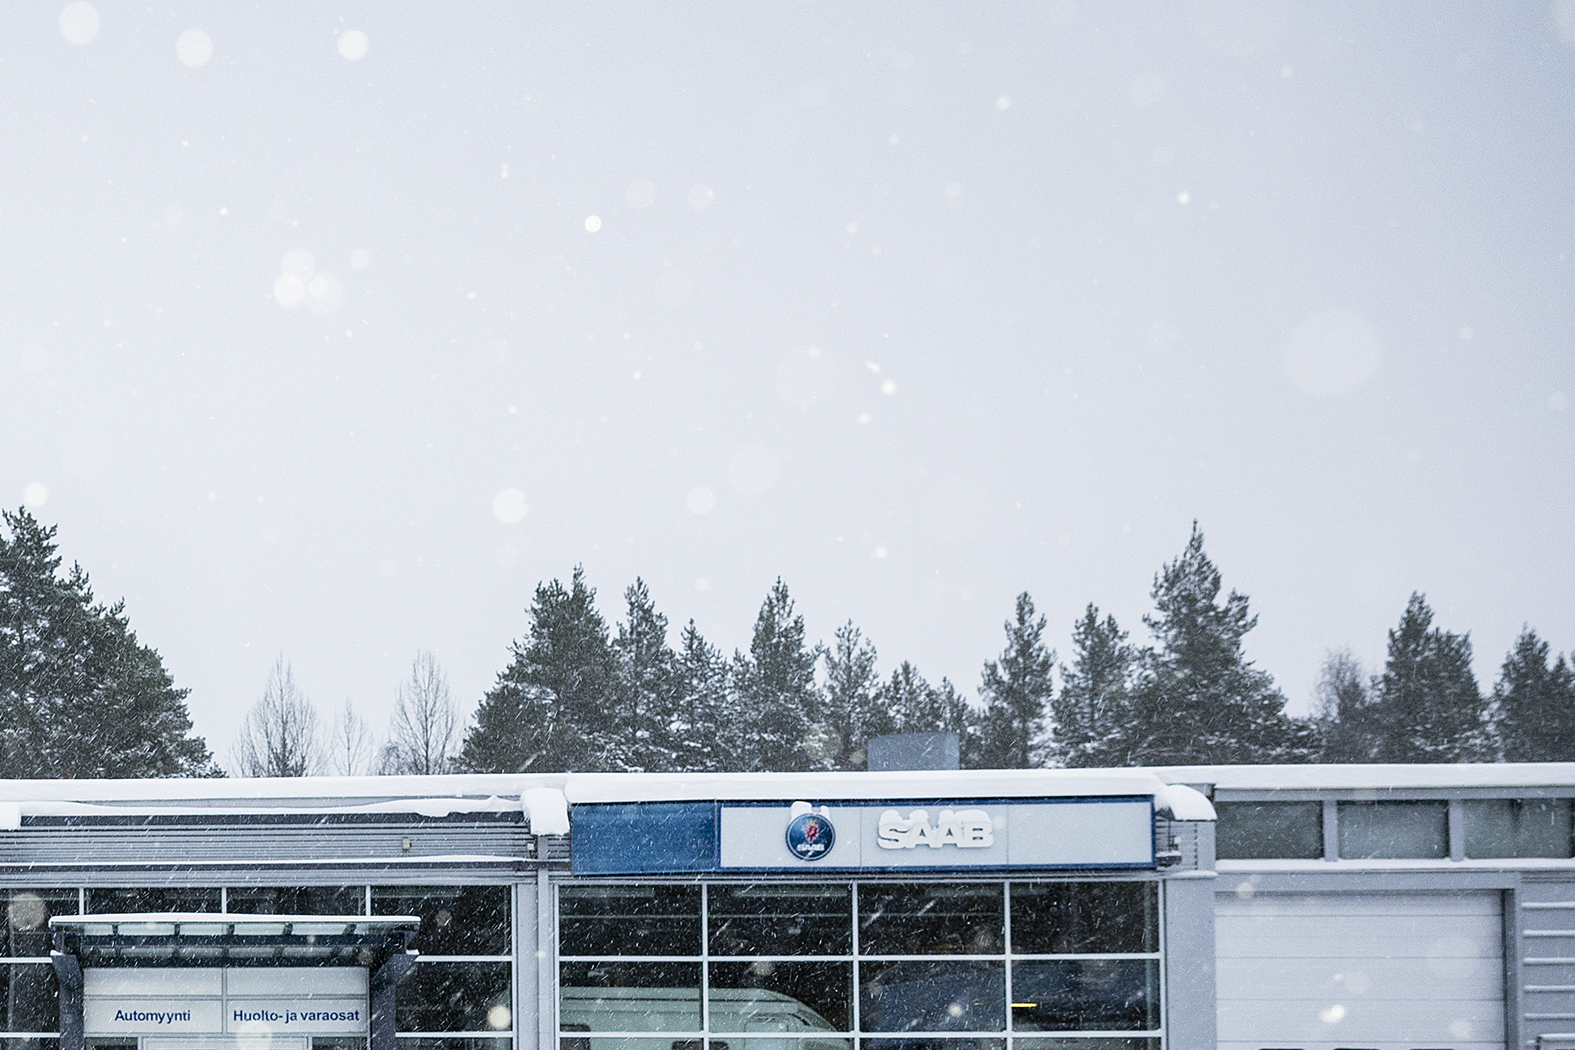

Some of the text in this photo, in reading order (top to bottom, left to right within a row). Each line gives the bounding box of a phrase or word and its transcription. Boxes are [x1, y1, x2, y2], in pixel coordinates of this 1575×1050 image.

[878, 819, 994, 850] SAAB
[114, 1010, 191, 1024] Automyynti
[233, 1010, 360, 1024] Huolto- ja varaosat
